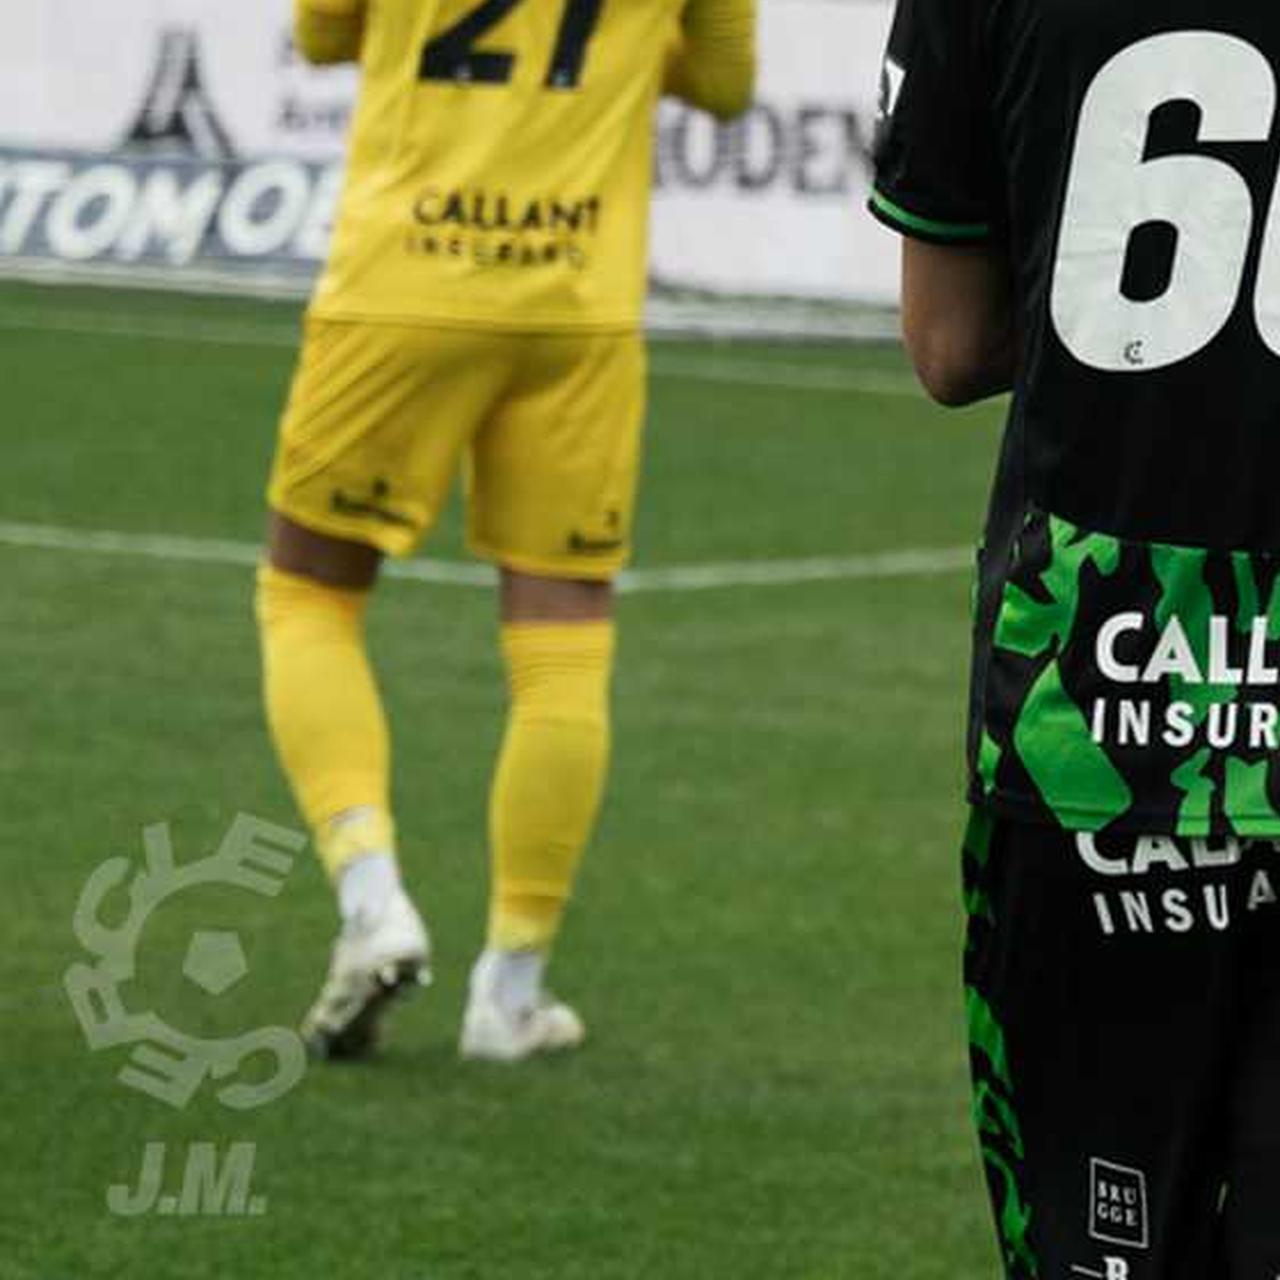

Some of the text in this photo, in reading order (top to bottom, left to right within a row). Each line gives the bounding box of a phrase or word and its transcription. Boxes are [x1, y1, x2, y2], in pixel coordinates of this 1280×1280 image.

[655, 98, 880, 196] ODE
[0, 160, 347, 265] TOMO
[411, 184, 602, 234] CALLANT
